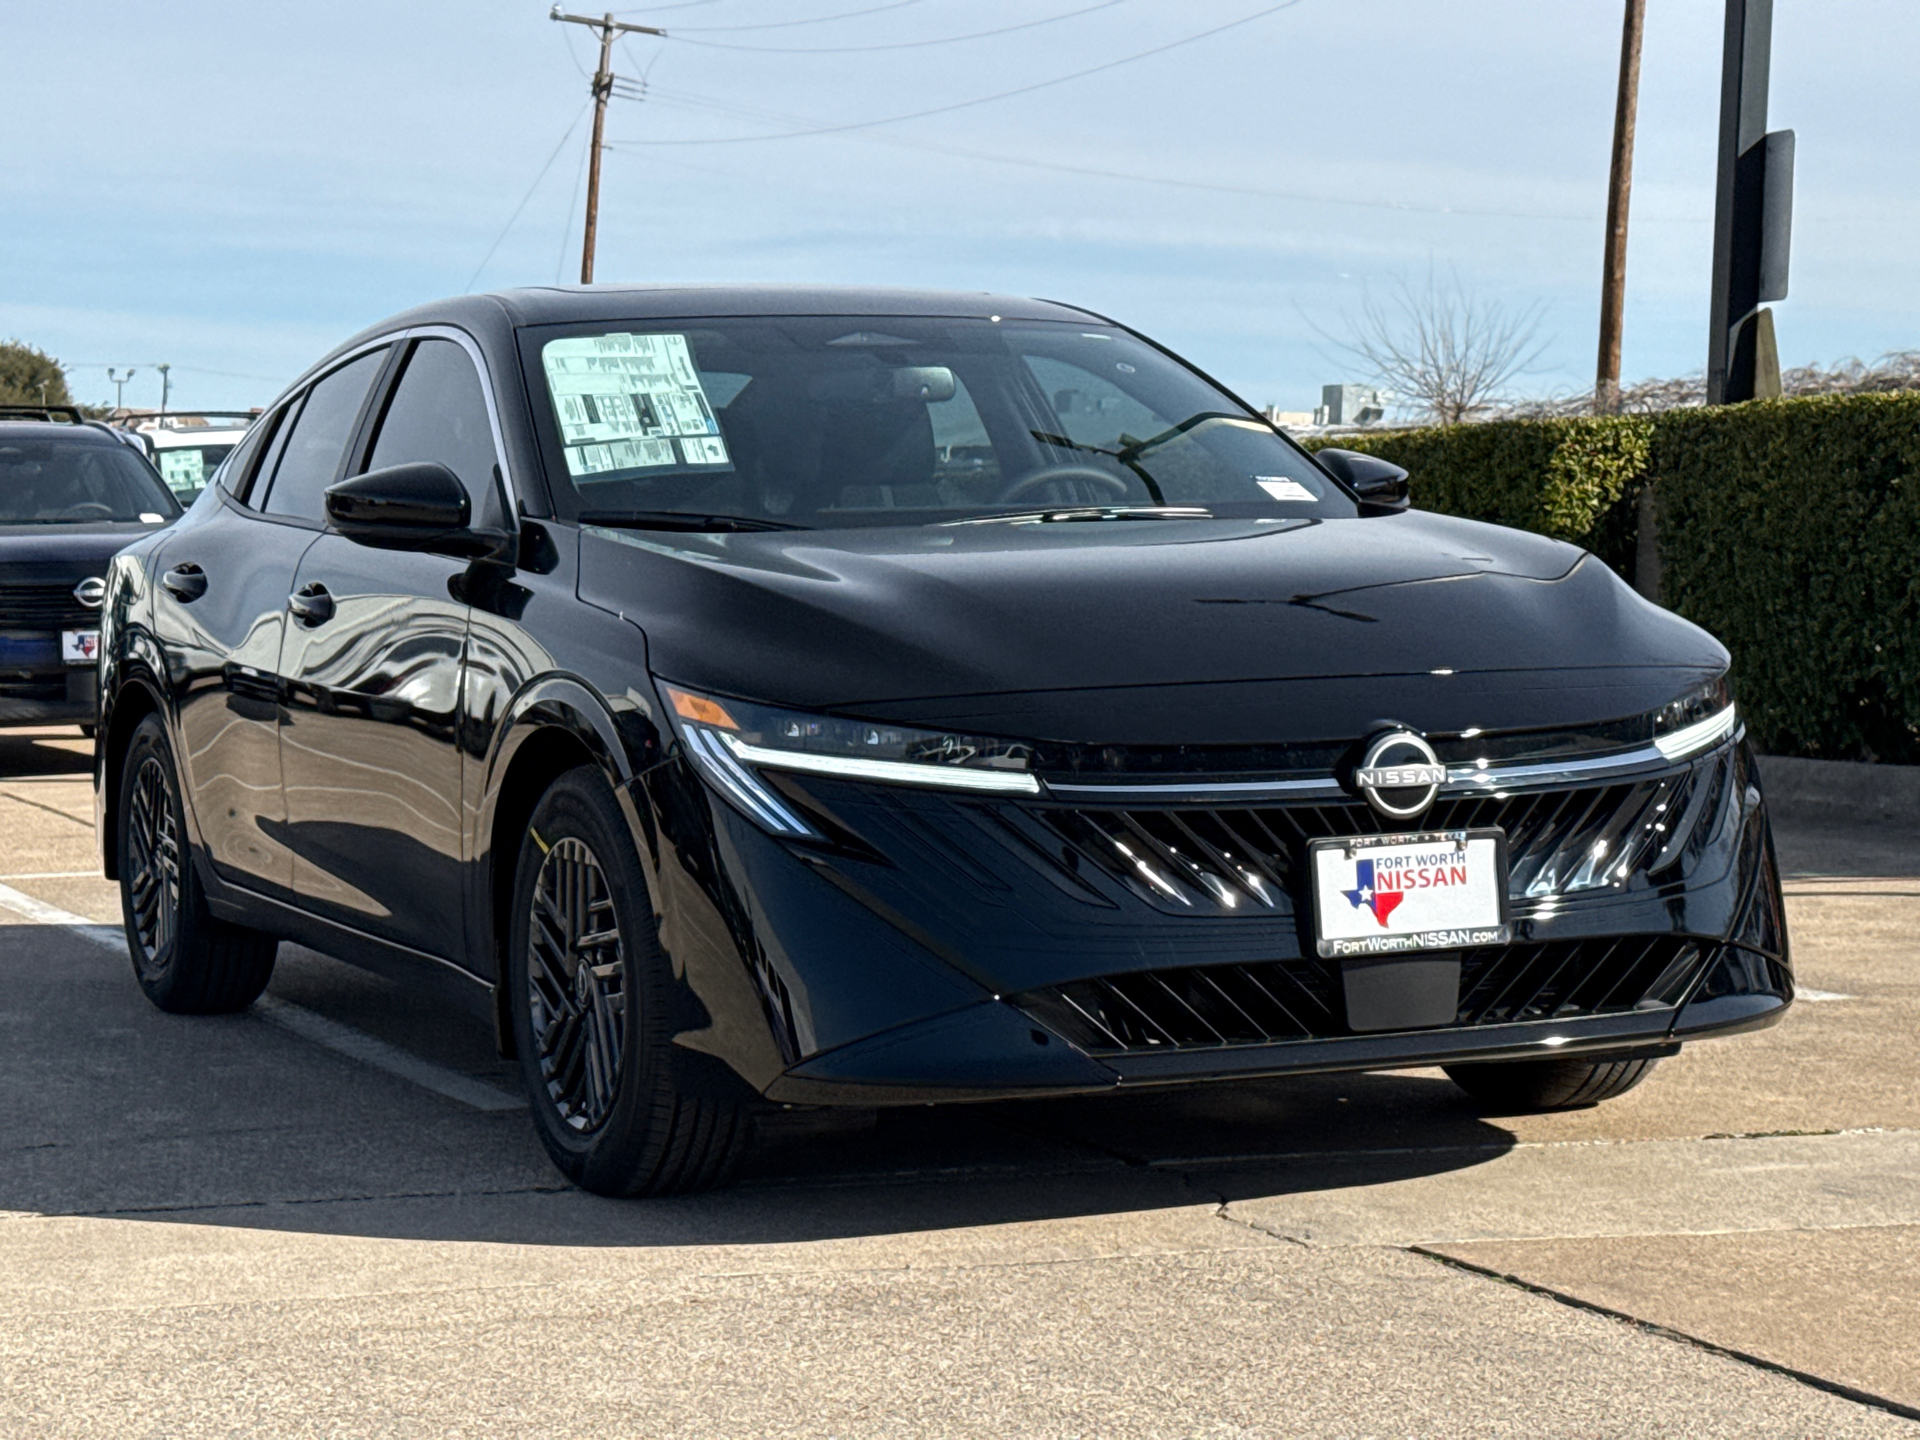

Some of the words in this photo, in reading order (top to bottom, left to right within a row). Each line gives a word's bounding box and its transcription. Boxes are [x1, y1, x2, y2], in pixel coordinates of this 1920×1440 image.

[1359, 769, 1445, 785] NISSAN
[1350, 838, 1376, 847] FORT
[1381, 834, 1418, 845] WORTH
[1376, 857, 1412, 869] FORT
[1416, 852, 1466, 867] WORTH
[1377, 866, 1466, 890] NISSAN
